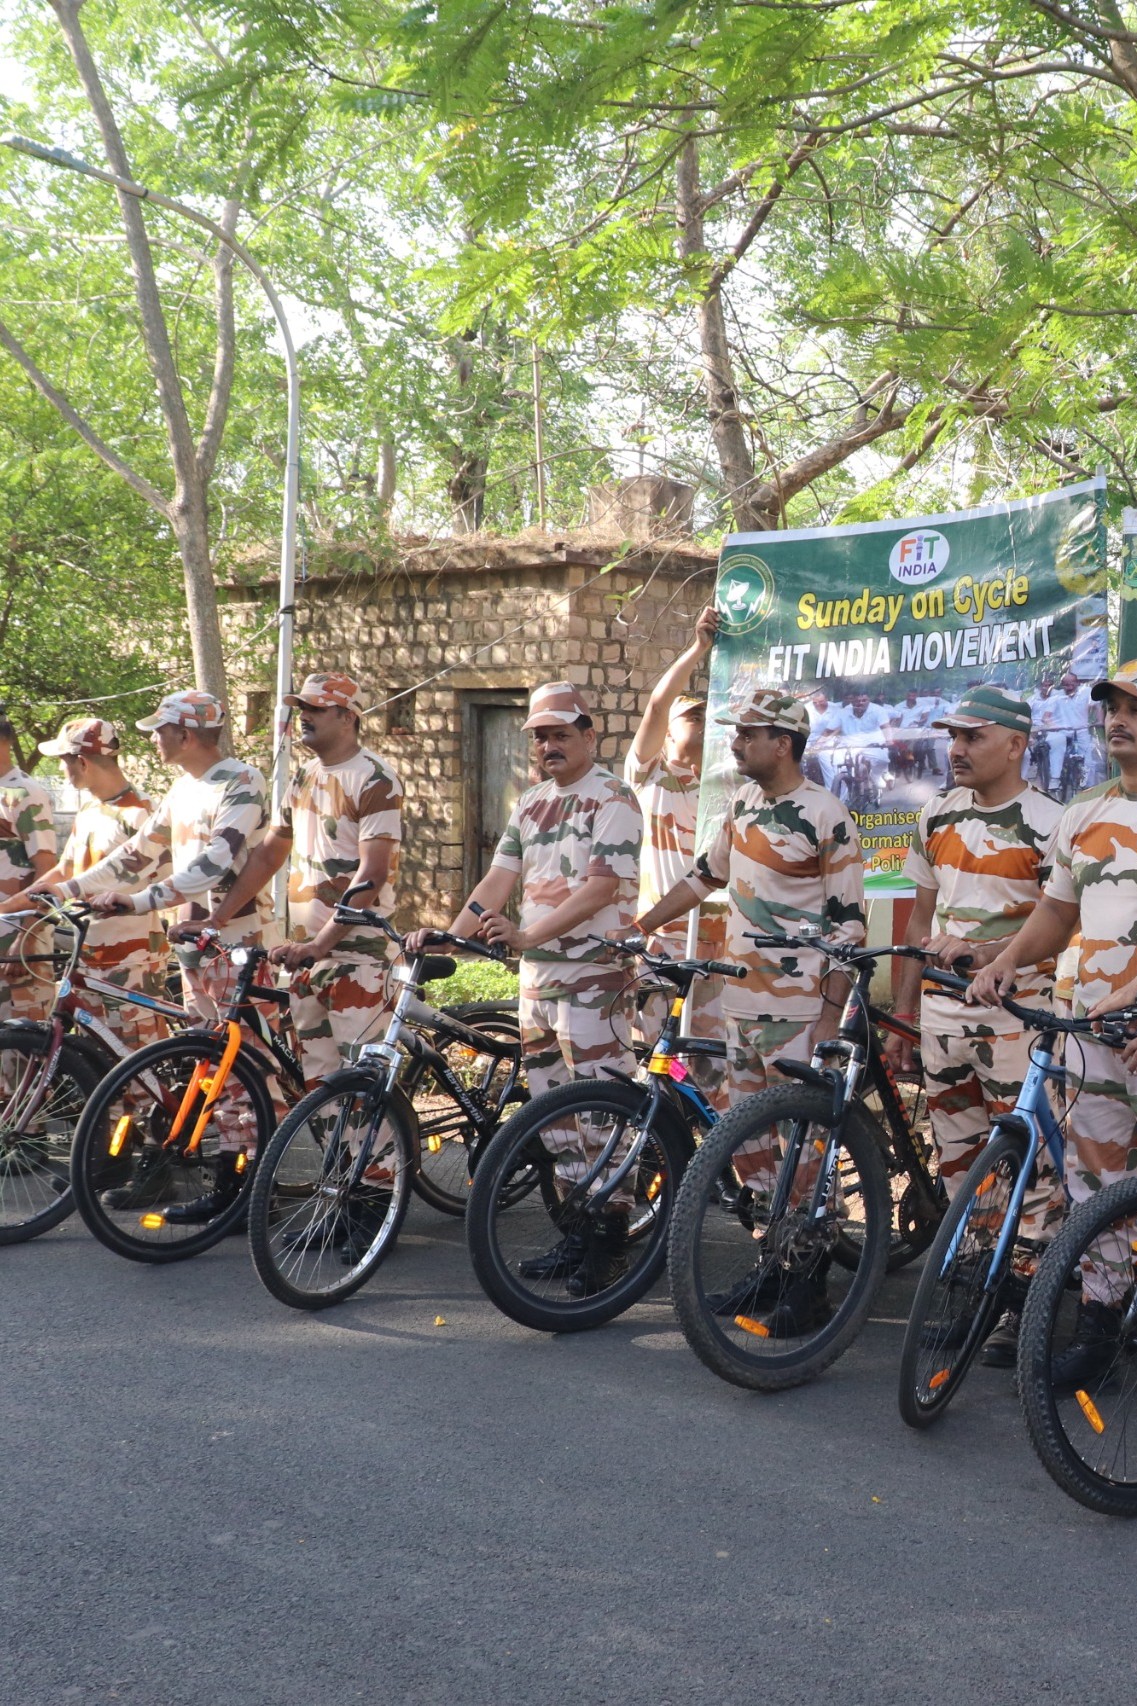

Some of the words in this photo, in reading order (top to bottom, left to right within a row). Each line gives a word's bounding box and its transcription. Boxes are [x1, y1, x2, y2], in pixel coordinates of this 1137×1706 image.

[897, 561, 937, 578] INDIA
[899, 534, 941, 563] FIT
[797, 577, 904, 632] Sunday
[911, 588, 944, 620] on
[953, 567, 1030, 623] Cycle
[767, 643, 811, 683] FIT
[815, 636, 891, 679] INDIA
[899, 615, 1054, 673] MOVEMENT
